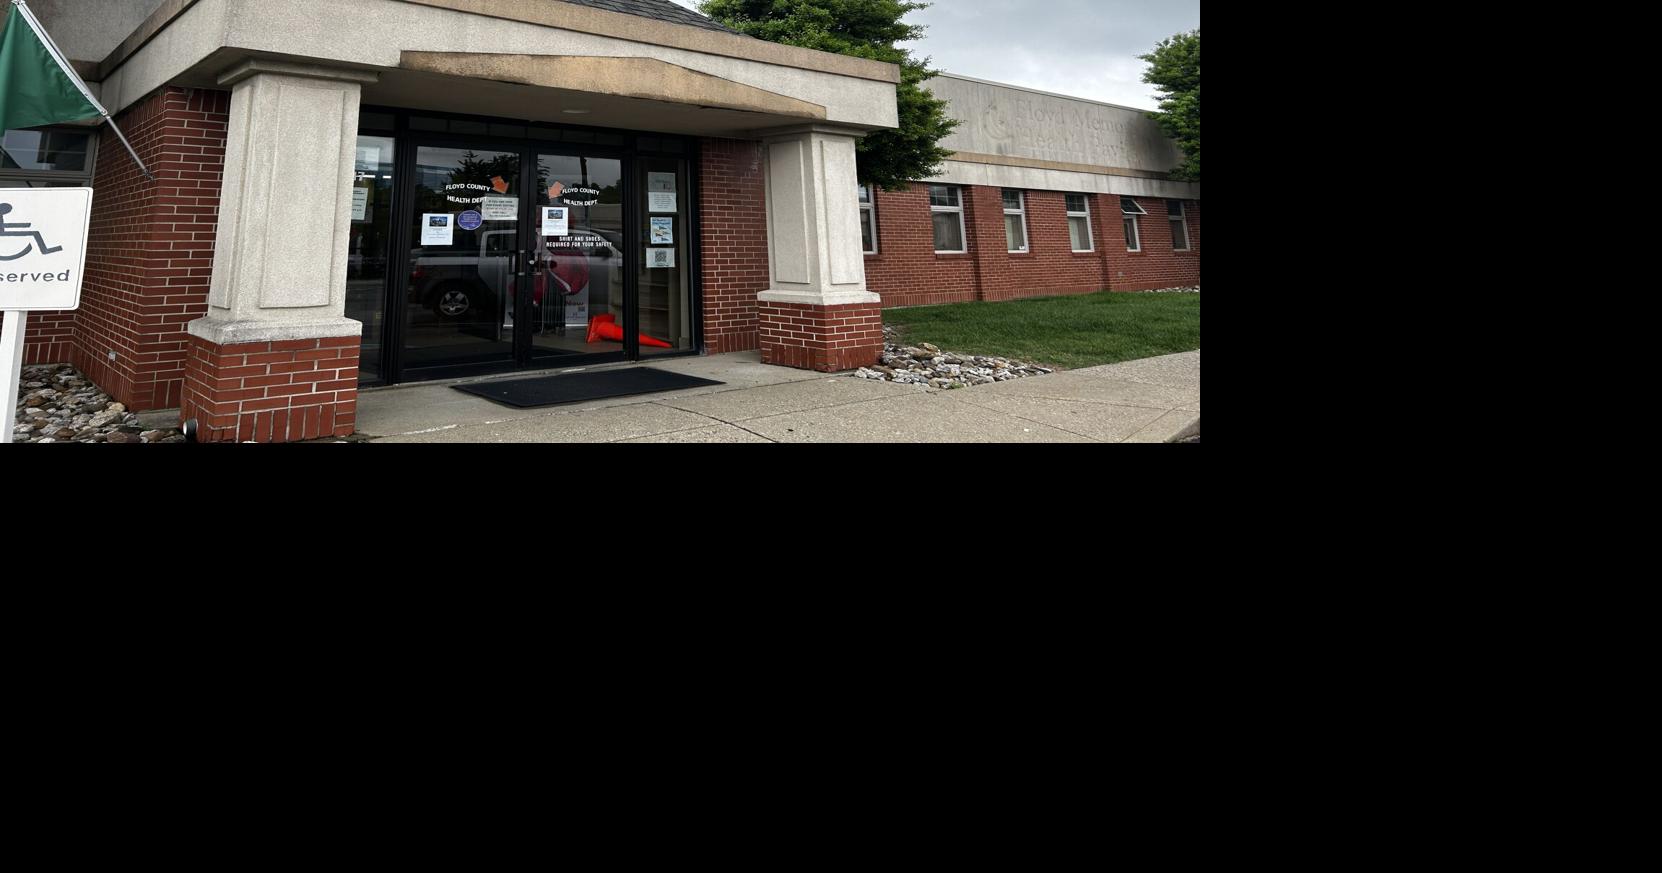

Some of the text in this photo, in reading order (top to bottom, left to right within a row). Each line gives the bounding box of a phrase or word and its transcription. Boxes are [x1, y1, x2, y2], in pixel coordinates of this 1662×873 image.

[466, 184, 491, 192] COUNTY
[579, 187, 600, 196] COUNTY
[447, 195, 487, 204] HEALTH DEPT
[563, 198, 584, 206] HEALTH
